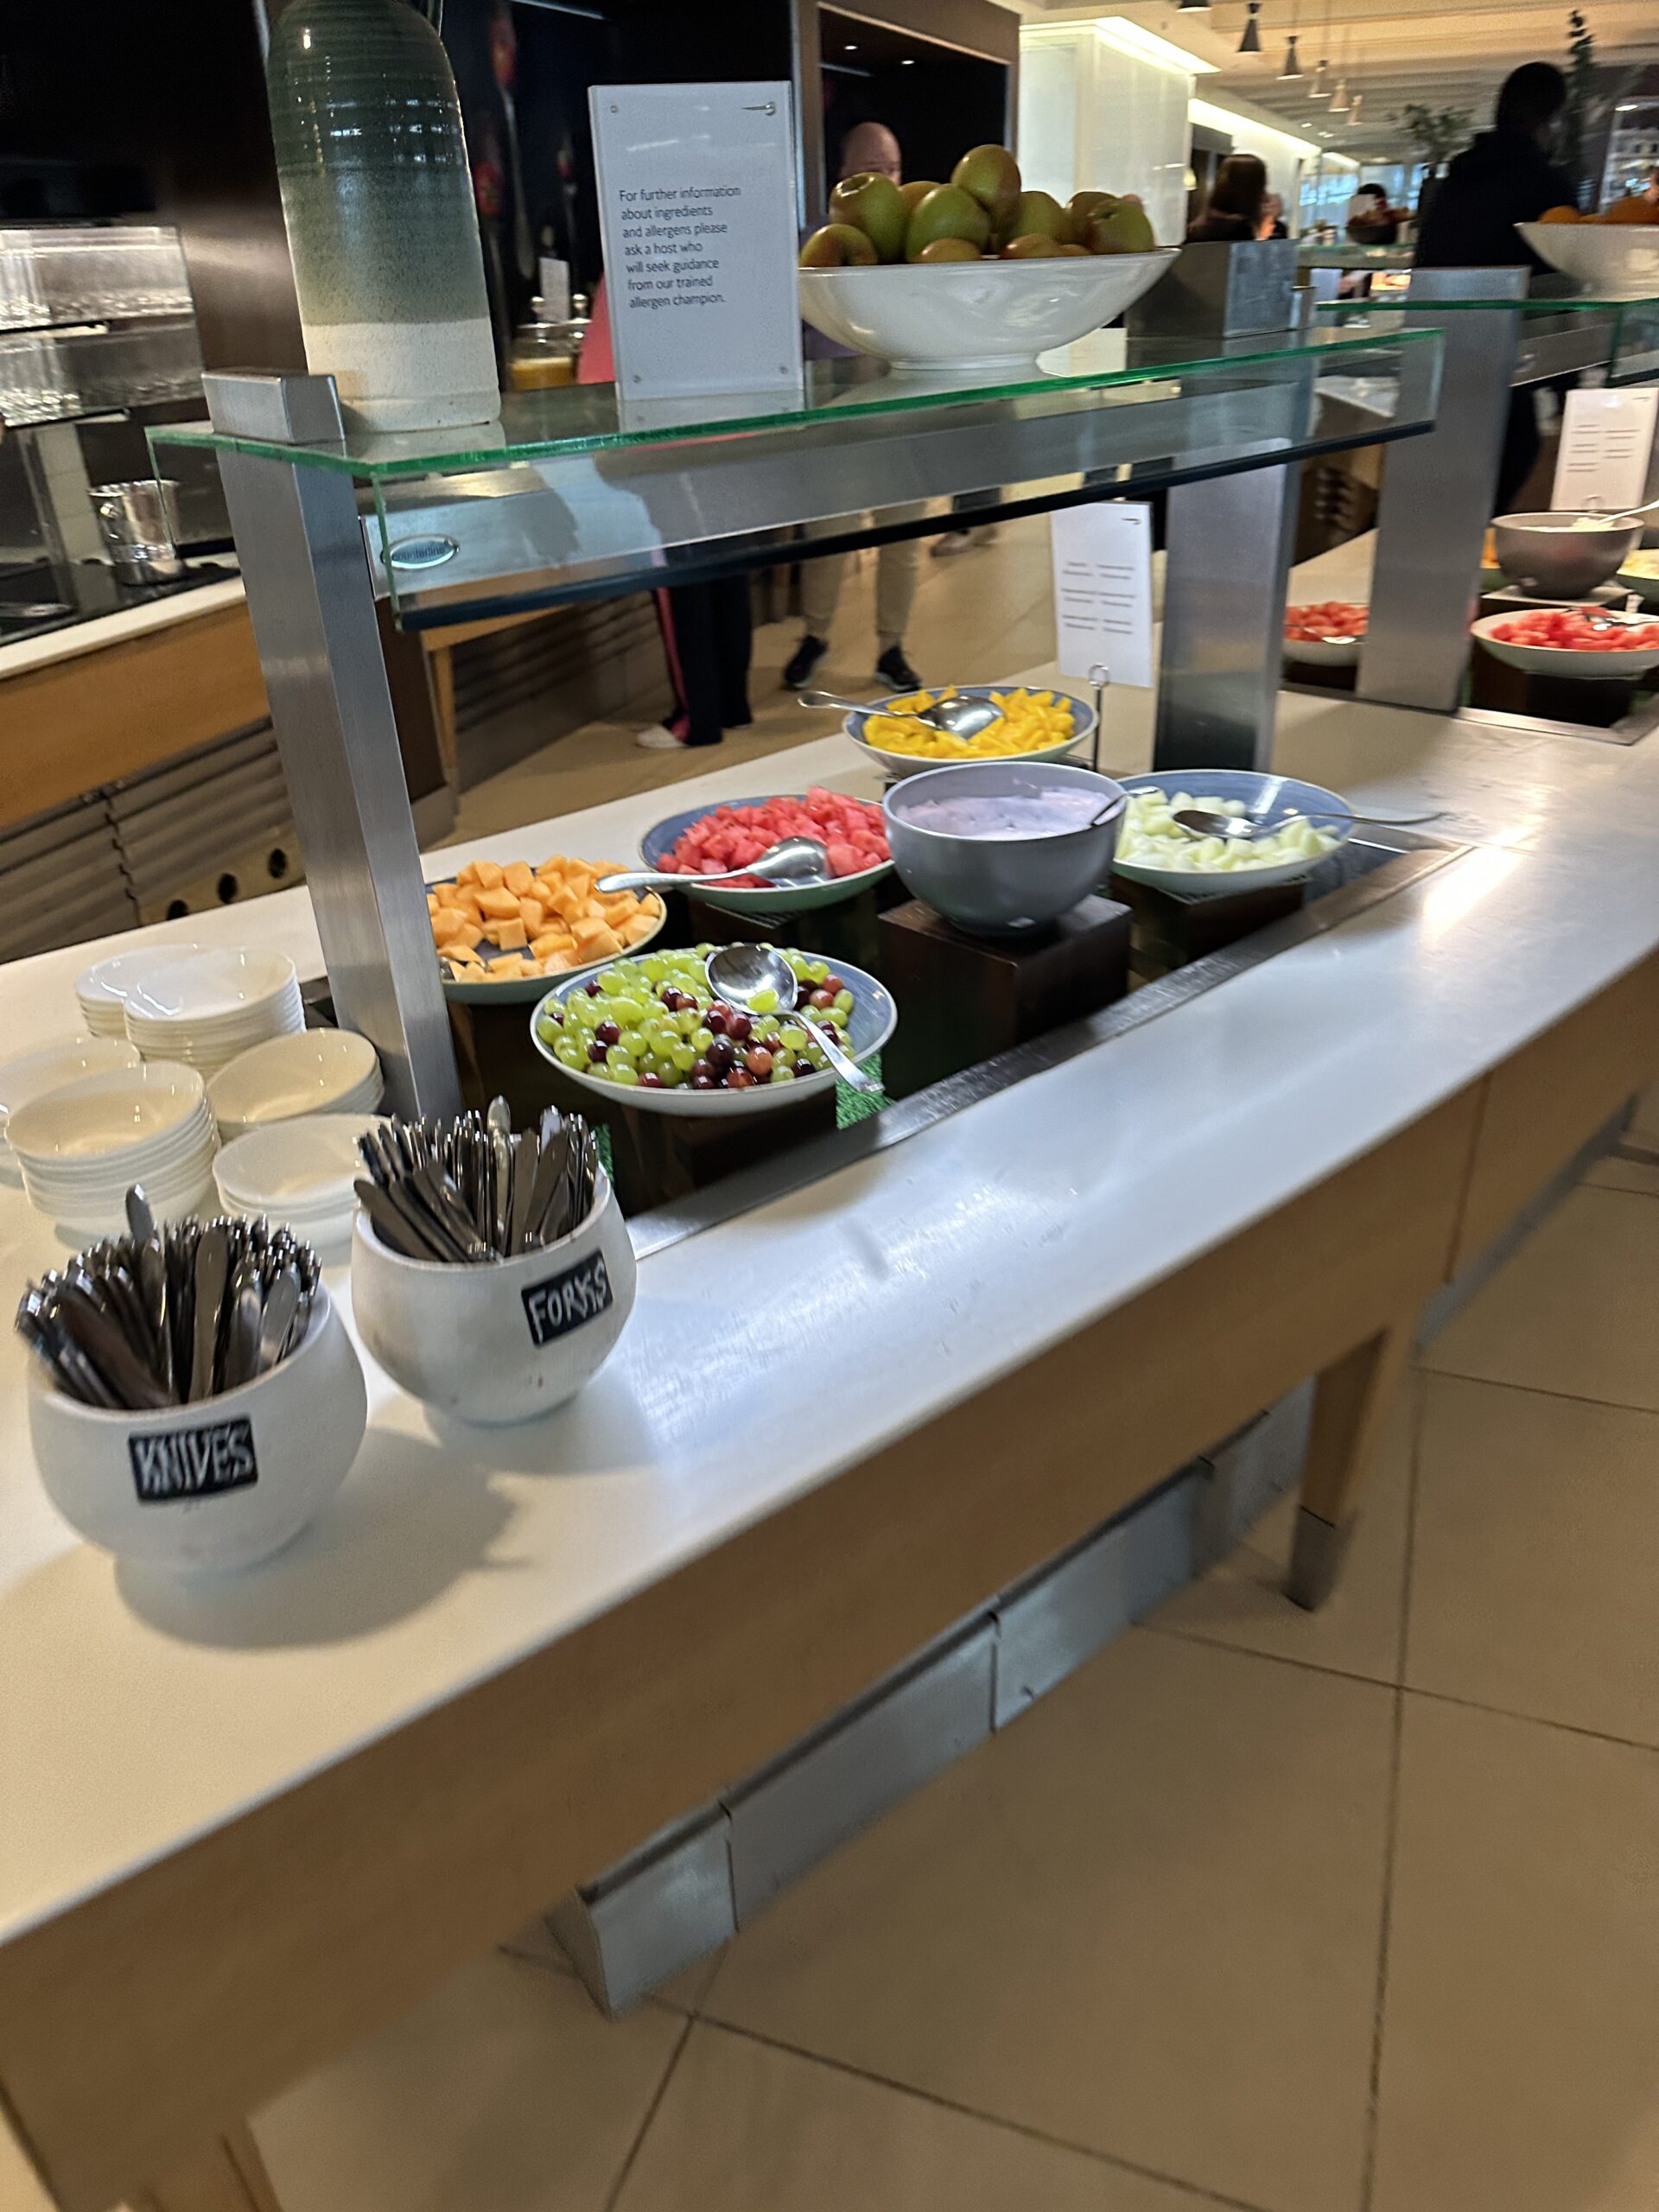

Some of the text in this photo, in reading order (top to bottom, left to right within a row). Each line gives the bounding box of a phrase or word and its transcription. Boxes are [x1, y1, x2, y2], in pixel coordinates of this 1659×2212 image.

[620, 185, 741, 201] For further information
[621, 205, 713, 220] about ingredients
[623, 222, 728, 238] and allergens please
[625, 241, 703, 256] ask a host who
[626, 258, 720, 274] will seek guidance
[628, 276, 713, 291] from our trained
[629, 296, 671, 310] allergen
[528, 1256, 607, 1344] FORKS
[135, 1422, 254, 1494] KNIVES
